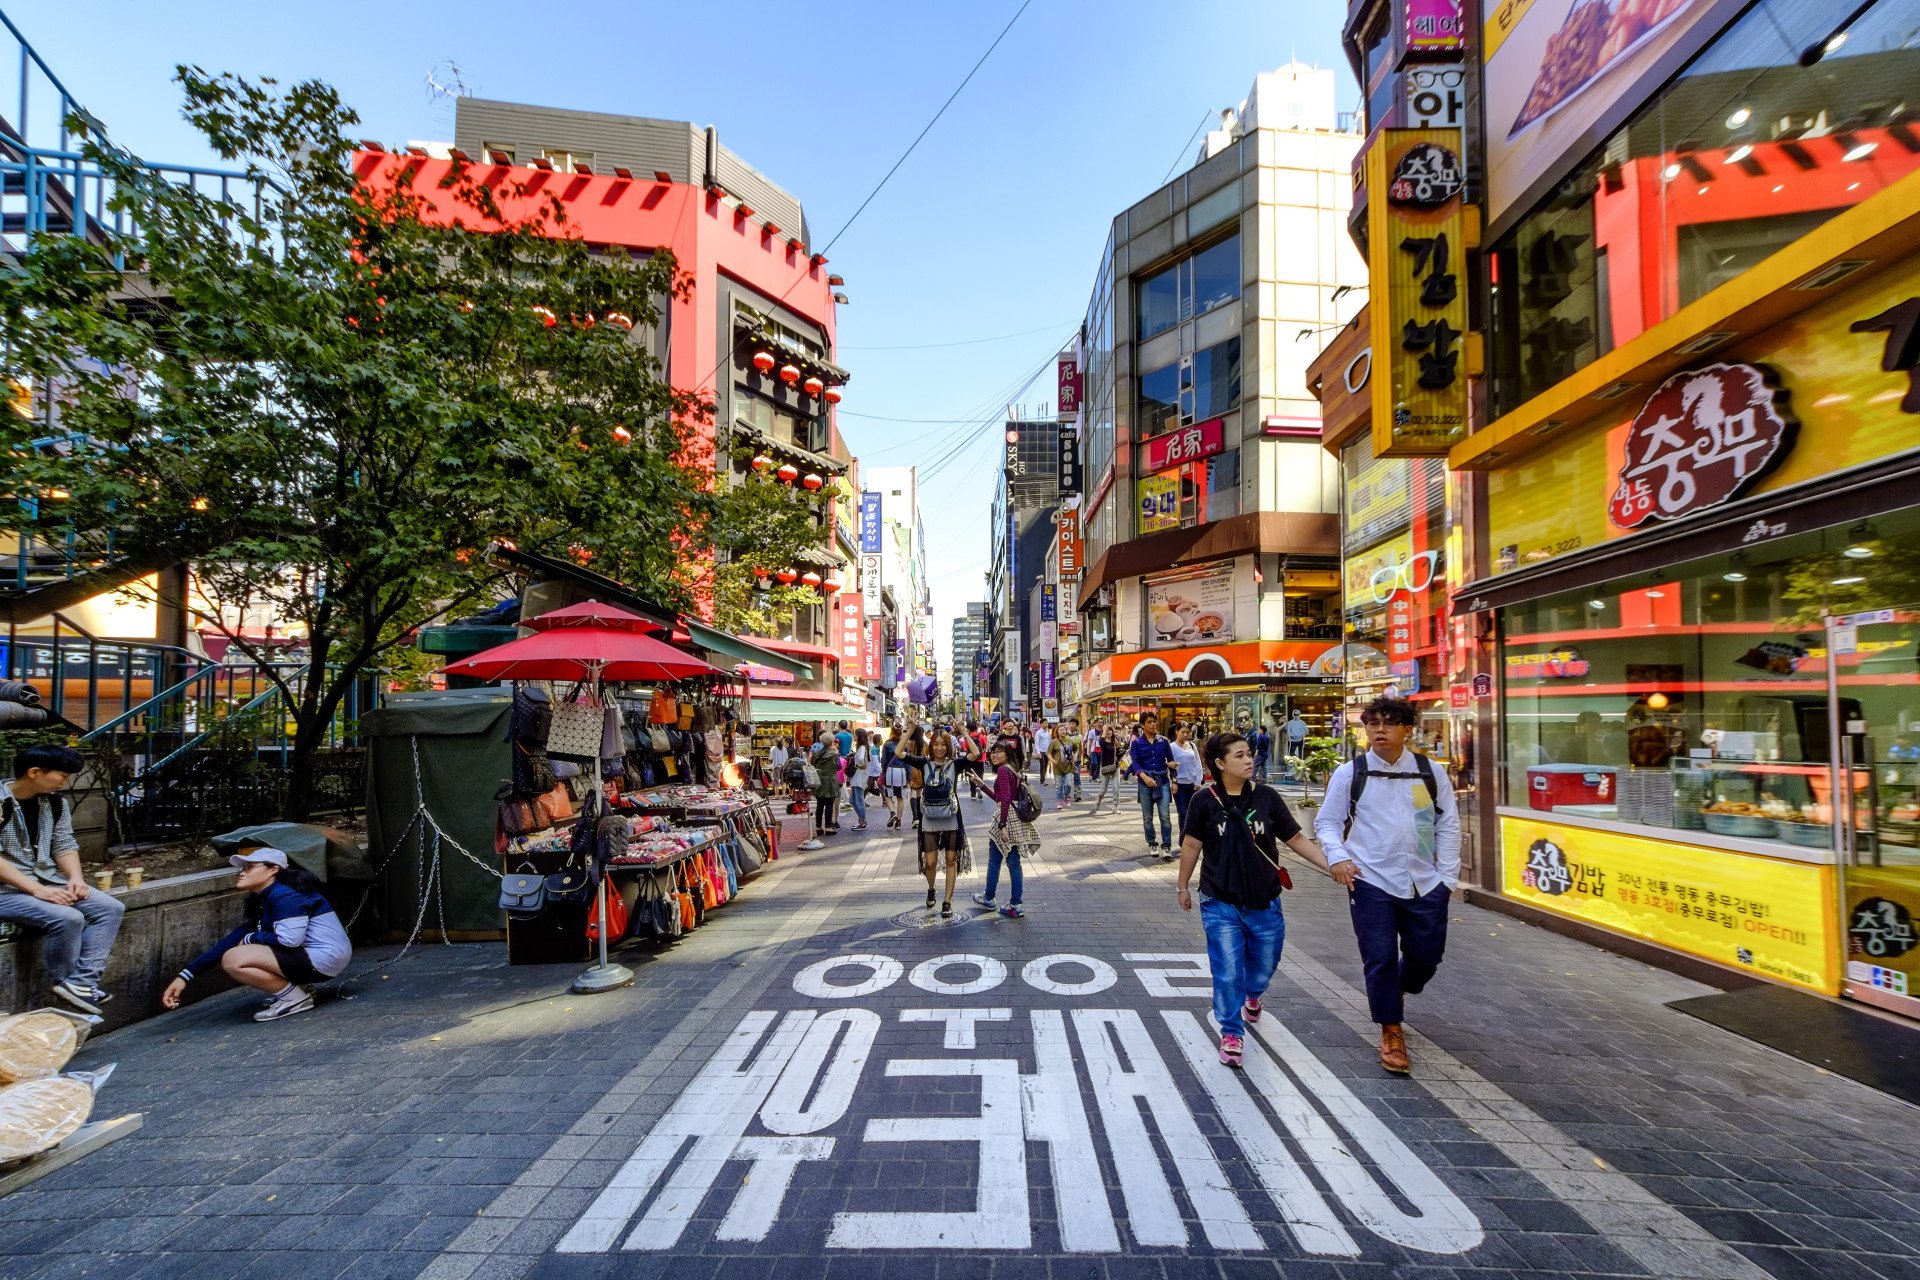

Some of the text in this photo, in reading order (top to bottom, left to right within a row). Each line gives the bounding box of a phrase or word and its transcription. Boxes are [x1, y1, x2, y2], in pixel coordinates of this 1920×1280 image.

[1399, 232, 1462, 389] 김밥
[1060, 431, 1076, 439] cafe
[1165, 429, 1203, 465] 名家
[1063, 440, 1073, 487] SOHO
[1141, 490, 1176, 519] 임대
[1613, 478, 1653, 517] 명동
[1062, 518, 1075, 571] 카이스트
[865, 623, 873, 676] BEAUTY SHOP
[1263, 657, 1310, 673] 카이스트
[1477, 684, 1487, 694] 33
[1521, 848, 1607, 898] 명동 충무 김밥
[1617, 872, 1770, 918] 30년 전통 명동 충무김밥!
[1617, 888, 1639, 905] 명동
